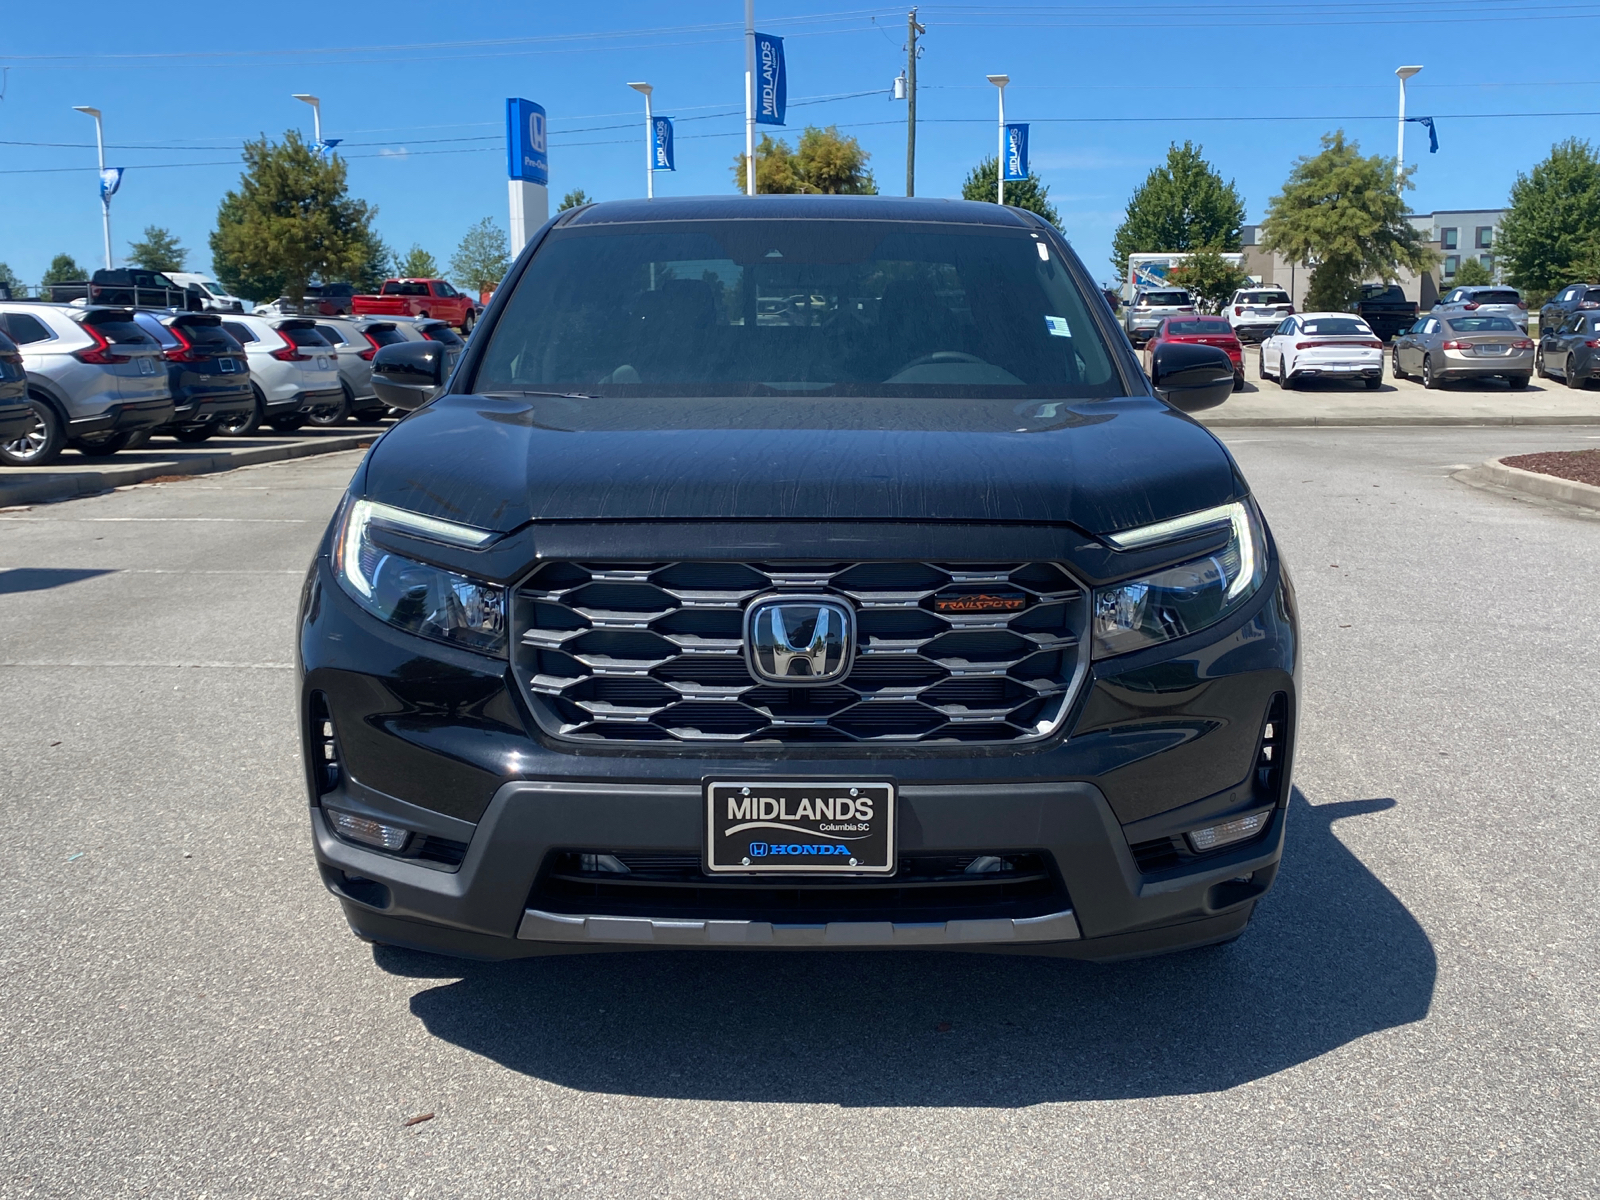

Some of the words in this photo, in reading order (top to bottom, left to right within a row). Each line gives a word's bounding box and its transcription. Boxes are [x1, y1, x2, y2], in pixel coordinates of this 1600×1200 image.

[761, 41, 773, 115] MIDLANDS
[656, 120, 665, 166] MIDLANDS
[1009, 128, 1018, 176] MIDLANDS
[937, 600, 1024, 610] TRAILSPORT
[727, 797, 874, 821] MIDLANDS
[819, 823, 857, 831] Columbia
[857, 823, 870, 831] SC
[770, 844, 851, 855] HONDA
